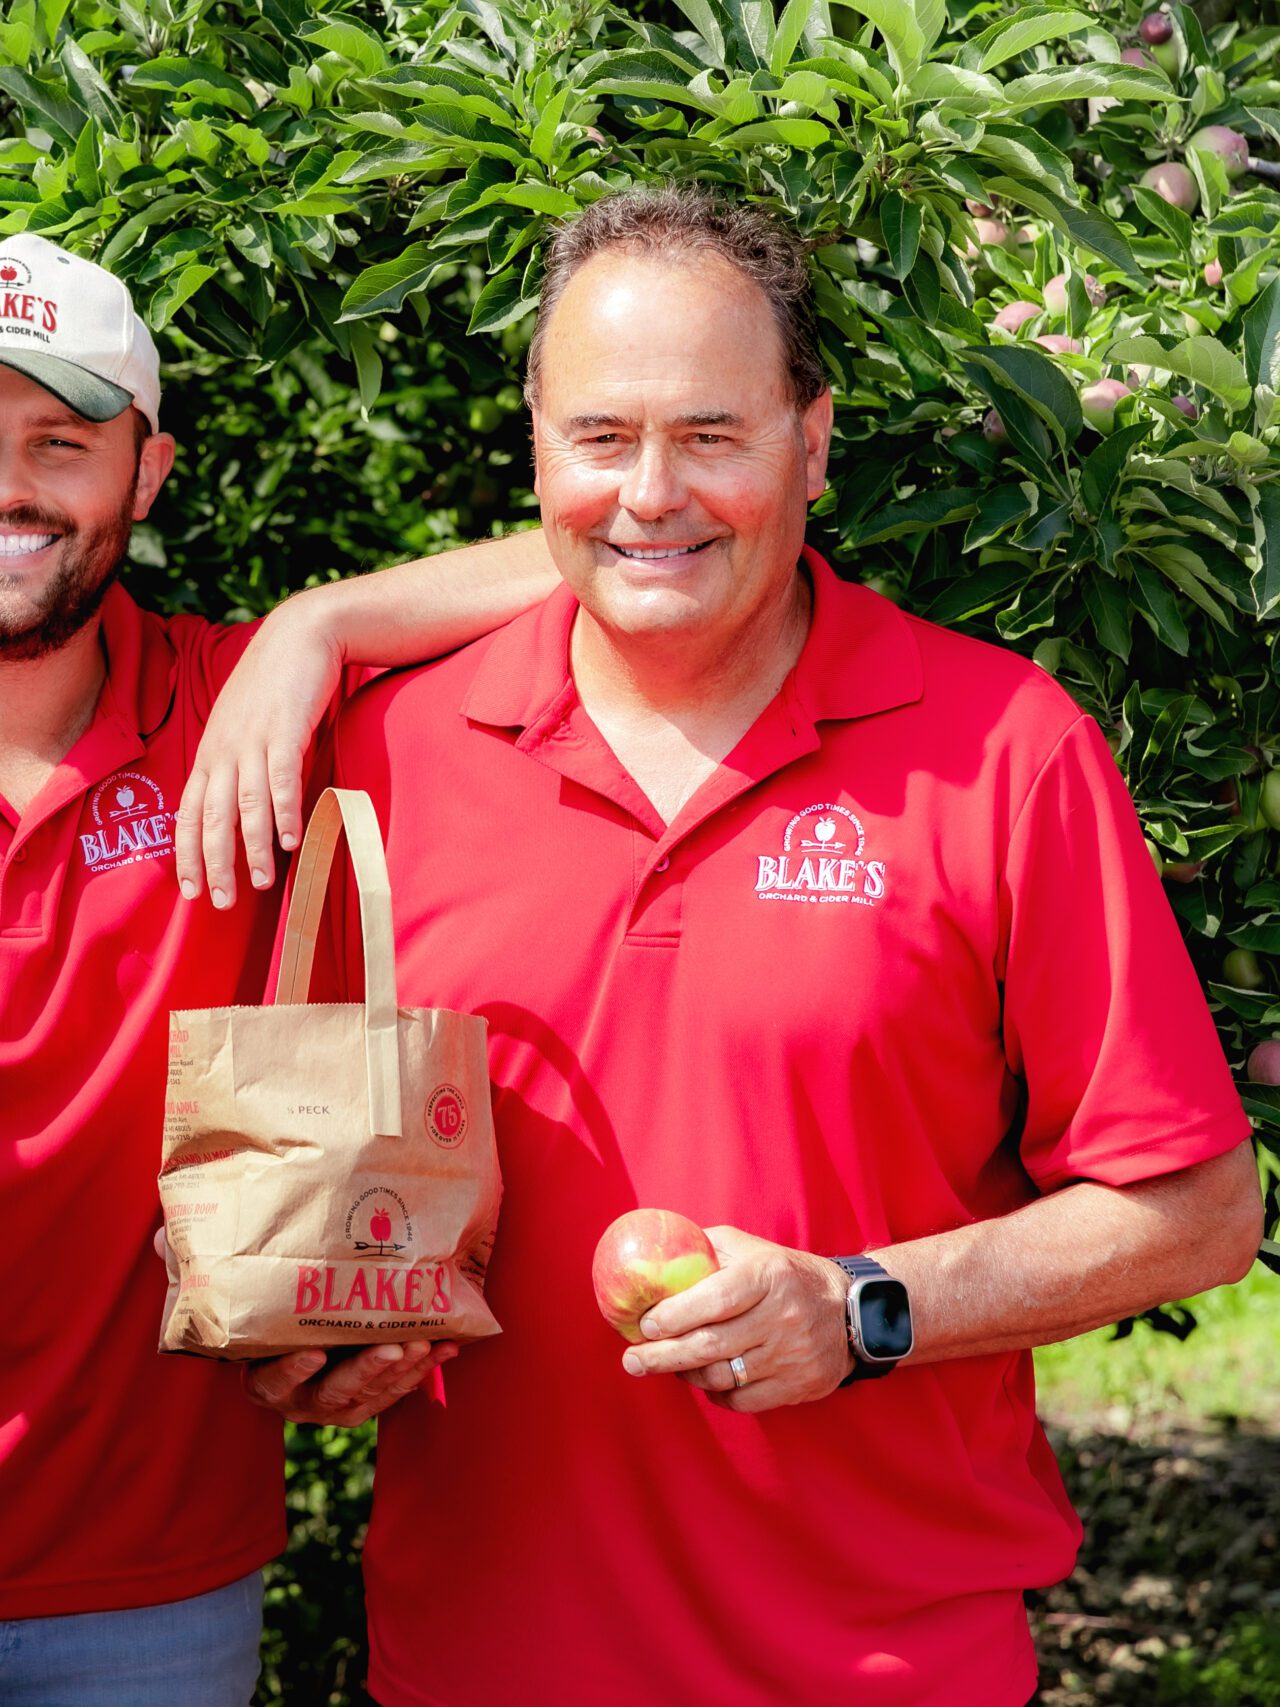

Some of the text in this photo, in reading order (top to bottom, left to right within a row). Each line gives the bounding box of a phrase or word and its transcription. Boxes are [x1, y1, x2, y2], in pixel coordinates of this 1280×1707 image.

[6, 326, 31, 336] CIDER
[33, 331, 50, 343] MILL
[140, 775, 160, 794] SINCE
[784, 815, 800, 851] GROWING
[800, 803, 824, 817] GOOD
[825, 803, 850, 816] TIMES
[848, 814, 865, 835] SINCE
[79, 811, 178, 866] BLAKE'
[91, 857, 134, 872] ORCHARD
[144, 848, 171, 859] CIDER
[754, 855, 885, 898] BLAKE'S
[758, 892, 807, 902] ORCHARD
[819, 895, 849, 903] CIDER
[851, 897, 875, 906] MILL
[299, 1106, 330, 1115] PECK
[437, 1104, 458, 1128] 75
[202, 1148, 235, 1162] ALMONT
[195, 1202, 218, 1215] ROOM
[345, 1201, 360, 1240] GROWING
[360, 1187, 378, 1201] GOOD
[379, 1187, 398, 1199] TIMES
[397, 1198, 409, 1222] SINCE
[293, 1265, 451, 1314] BLAKE'S
[299, 1318, 447, 1329] ORCHARD & CIDER MILL
